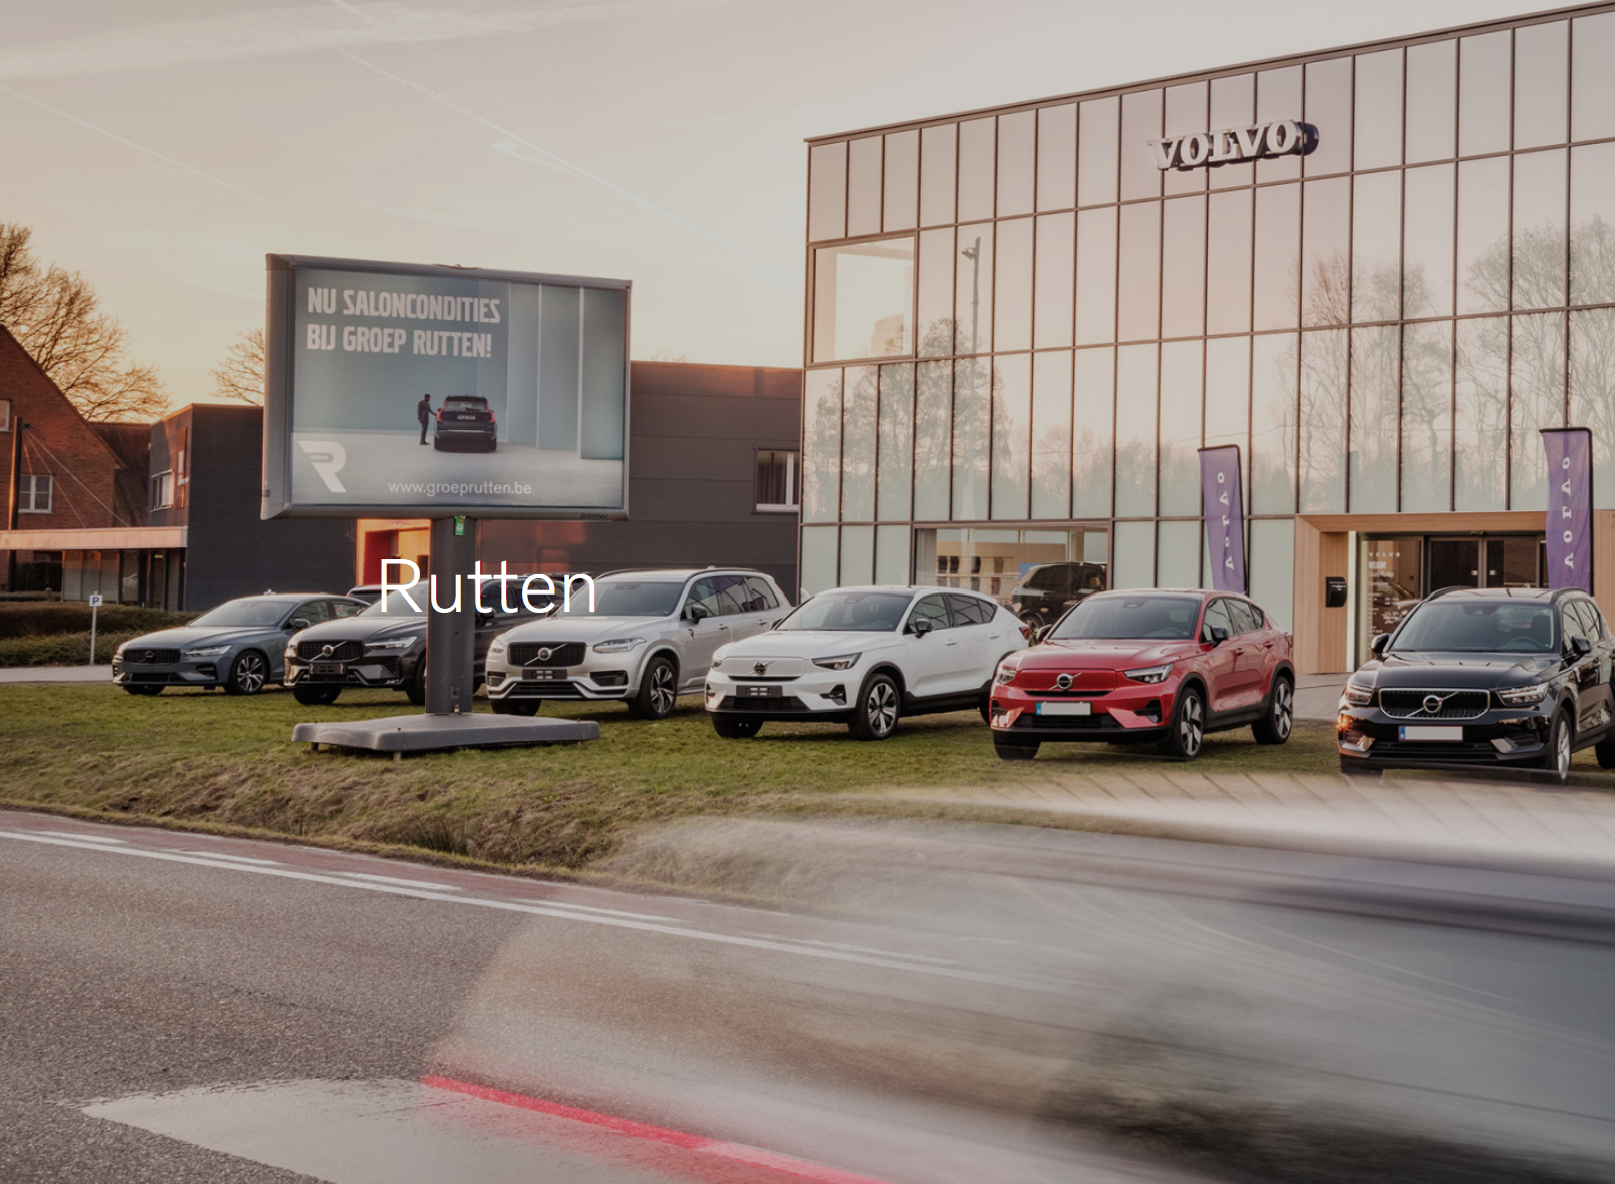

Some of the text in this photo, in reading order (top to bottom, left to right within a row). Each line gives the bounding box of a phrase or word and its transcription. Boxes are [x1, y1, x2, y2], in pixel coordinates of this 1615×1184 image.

[1148, 119, 1298, 170] VOLVO
[307, 287, 501, 323] NU SALONCONDITIES
[306, 324, 492, 358] BIJ GROEP RUTTEN!
[388, 481, 532, 497] www.groeprutten.be
[91, 596, 100, 605] P
